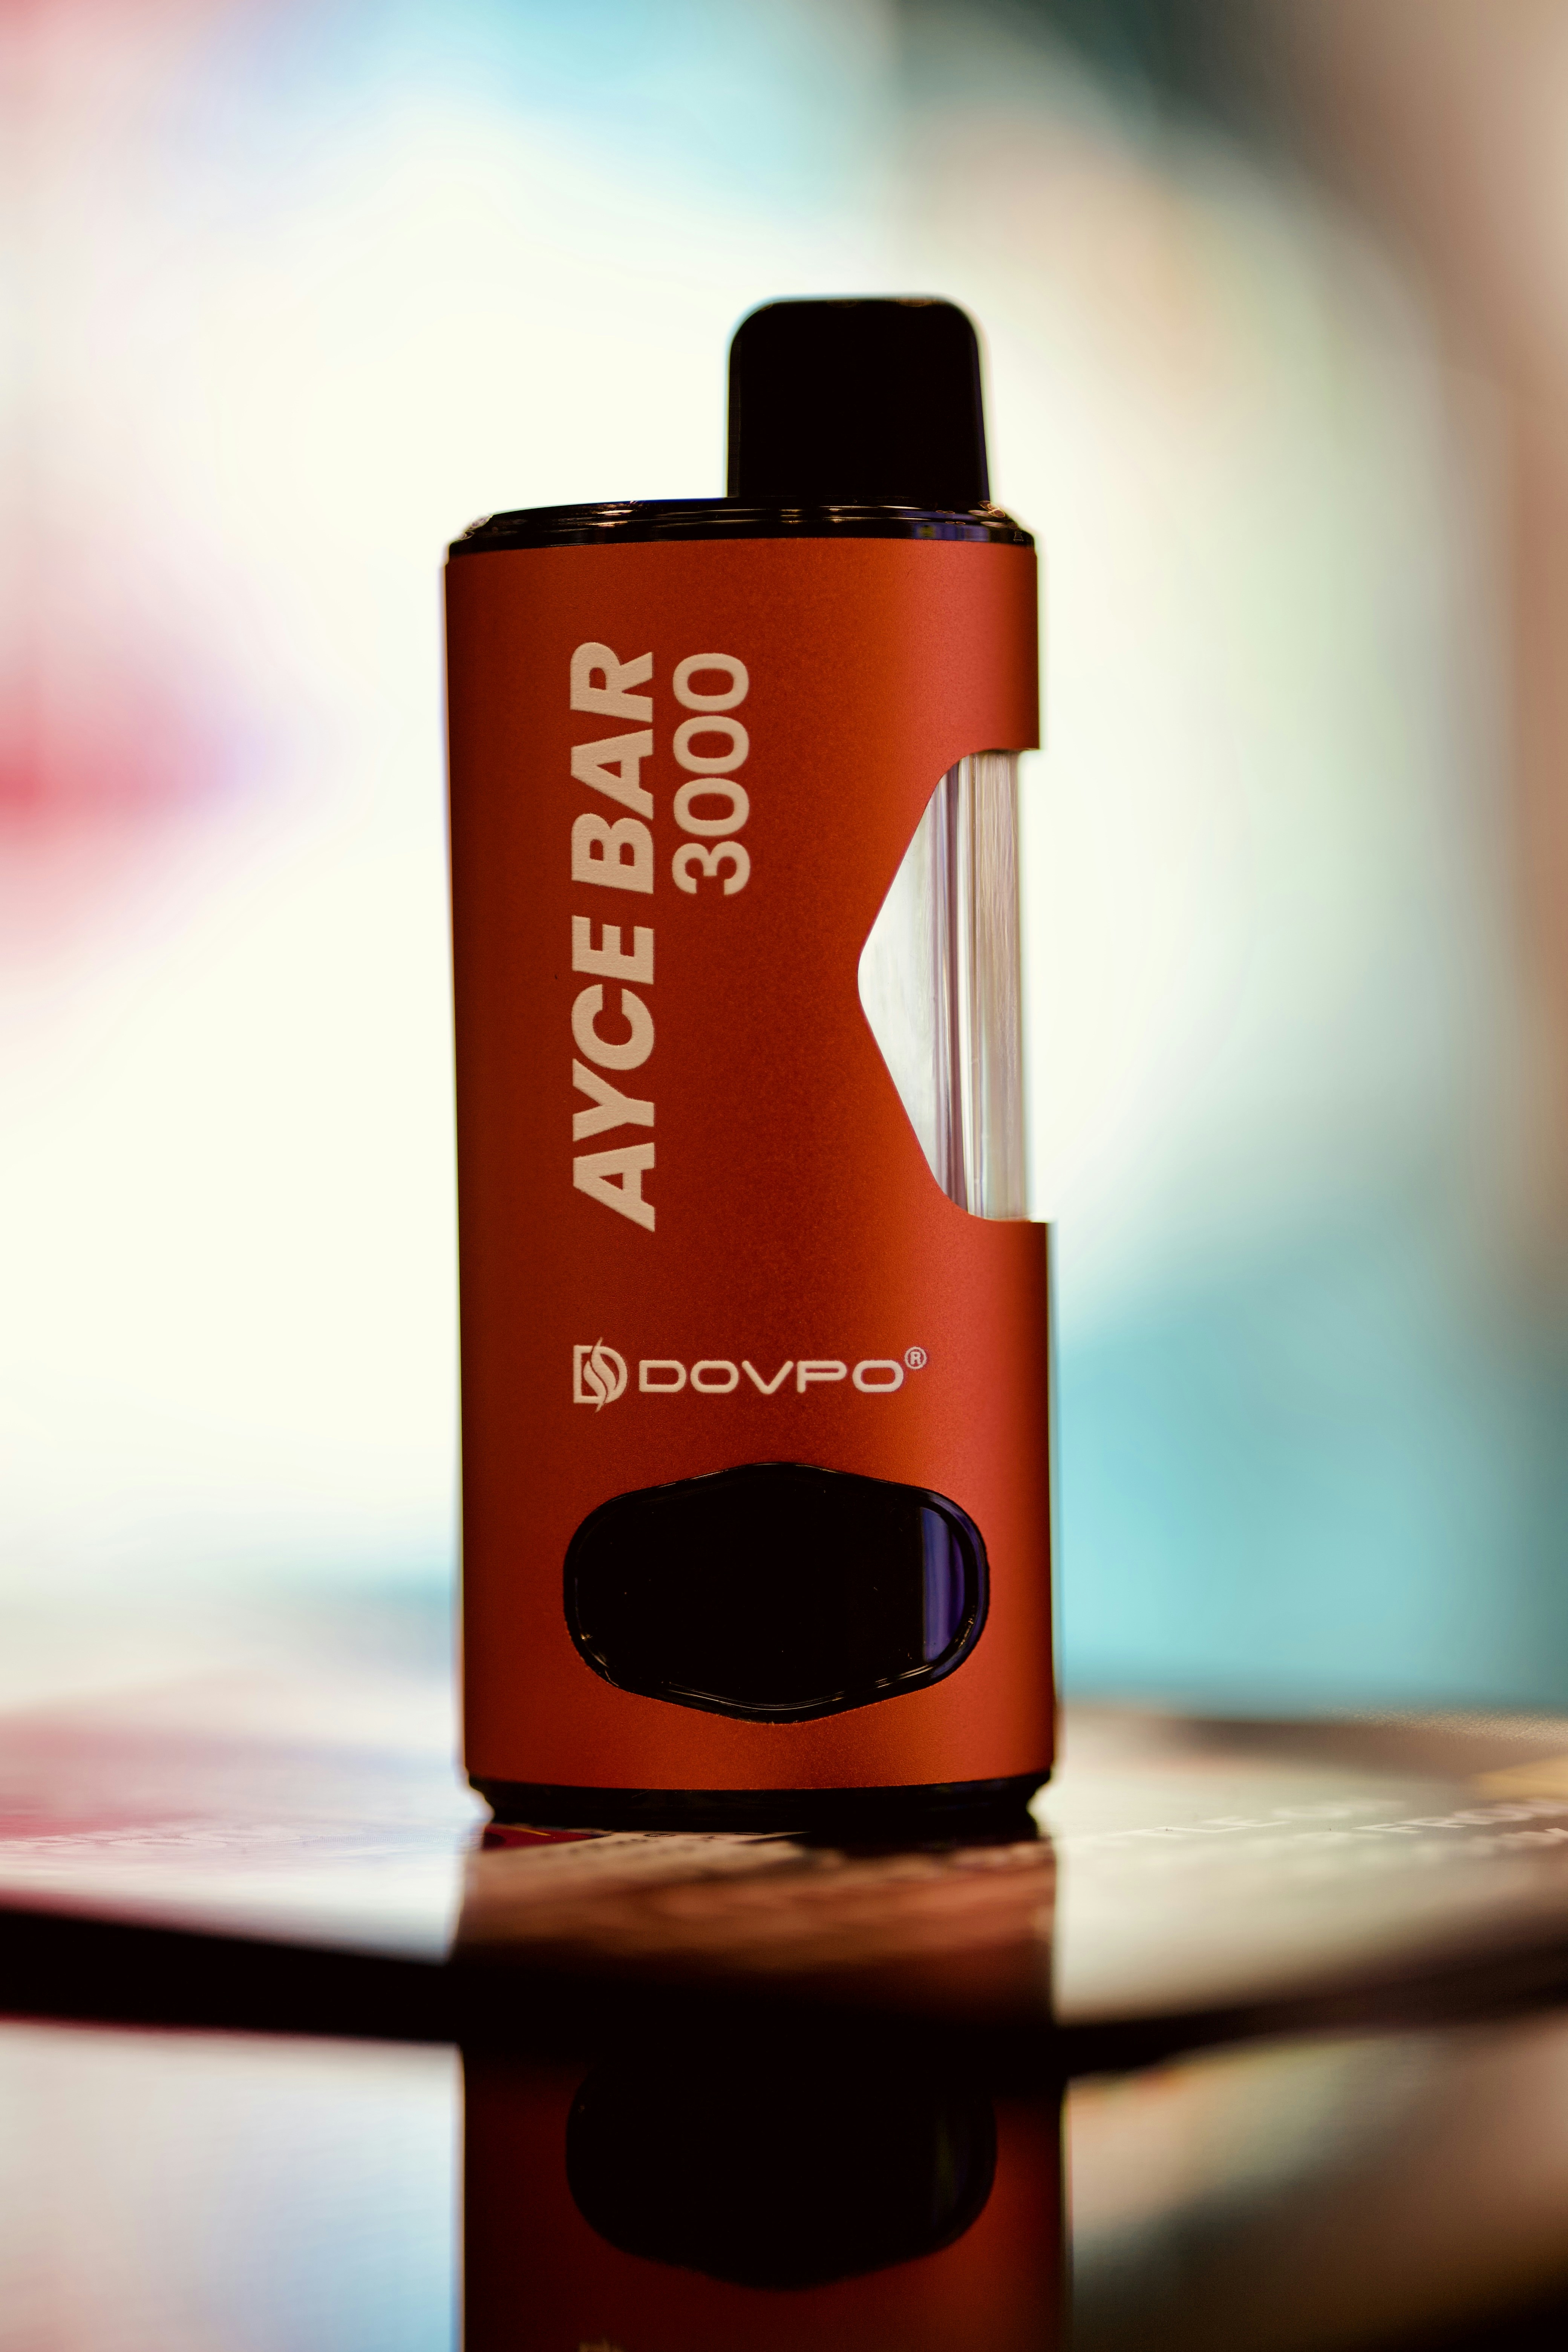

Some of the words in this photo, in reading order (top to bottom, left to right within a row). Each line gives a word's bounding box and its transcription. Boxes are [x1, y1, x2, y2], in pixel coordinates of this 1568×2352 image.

[570, 642, 654, 895] BAR
[672, 652, 750, 897] 3000
[571, 915, 655, 1232] AYCE
